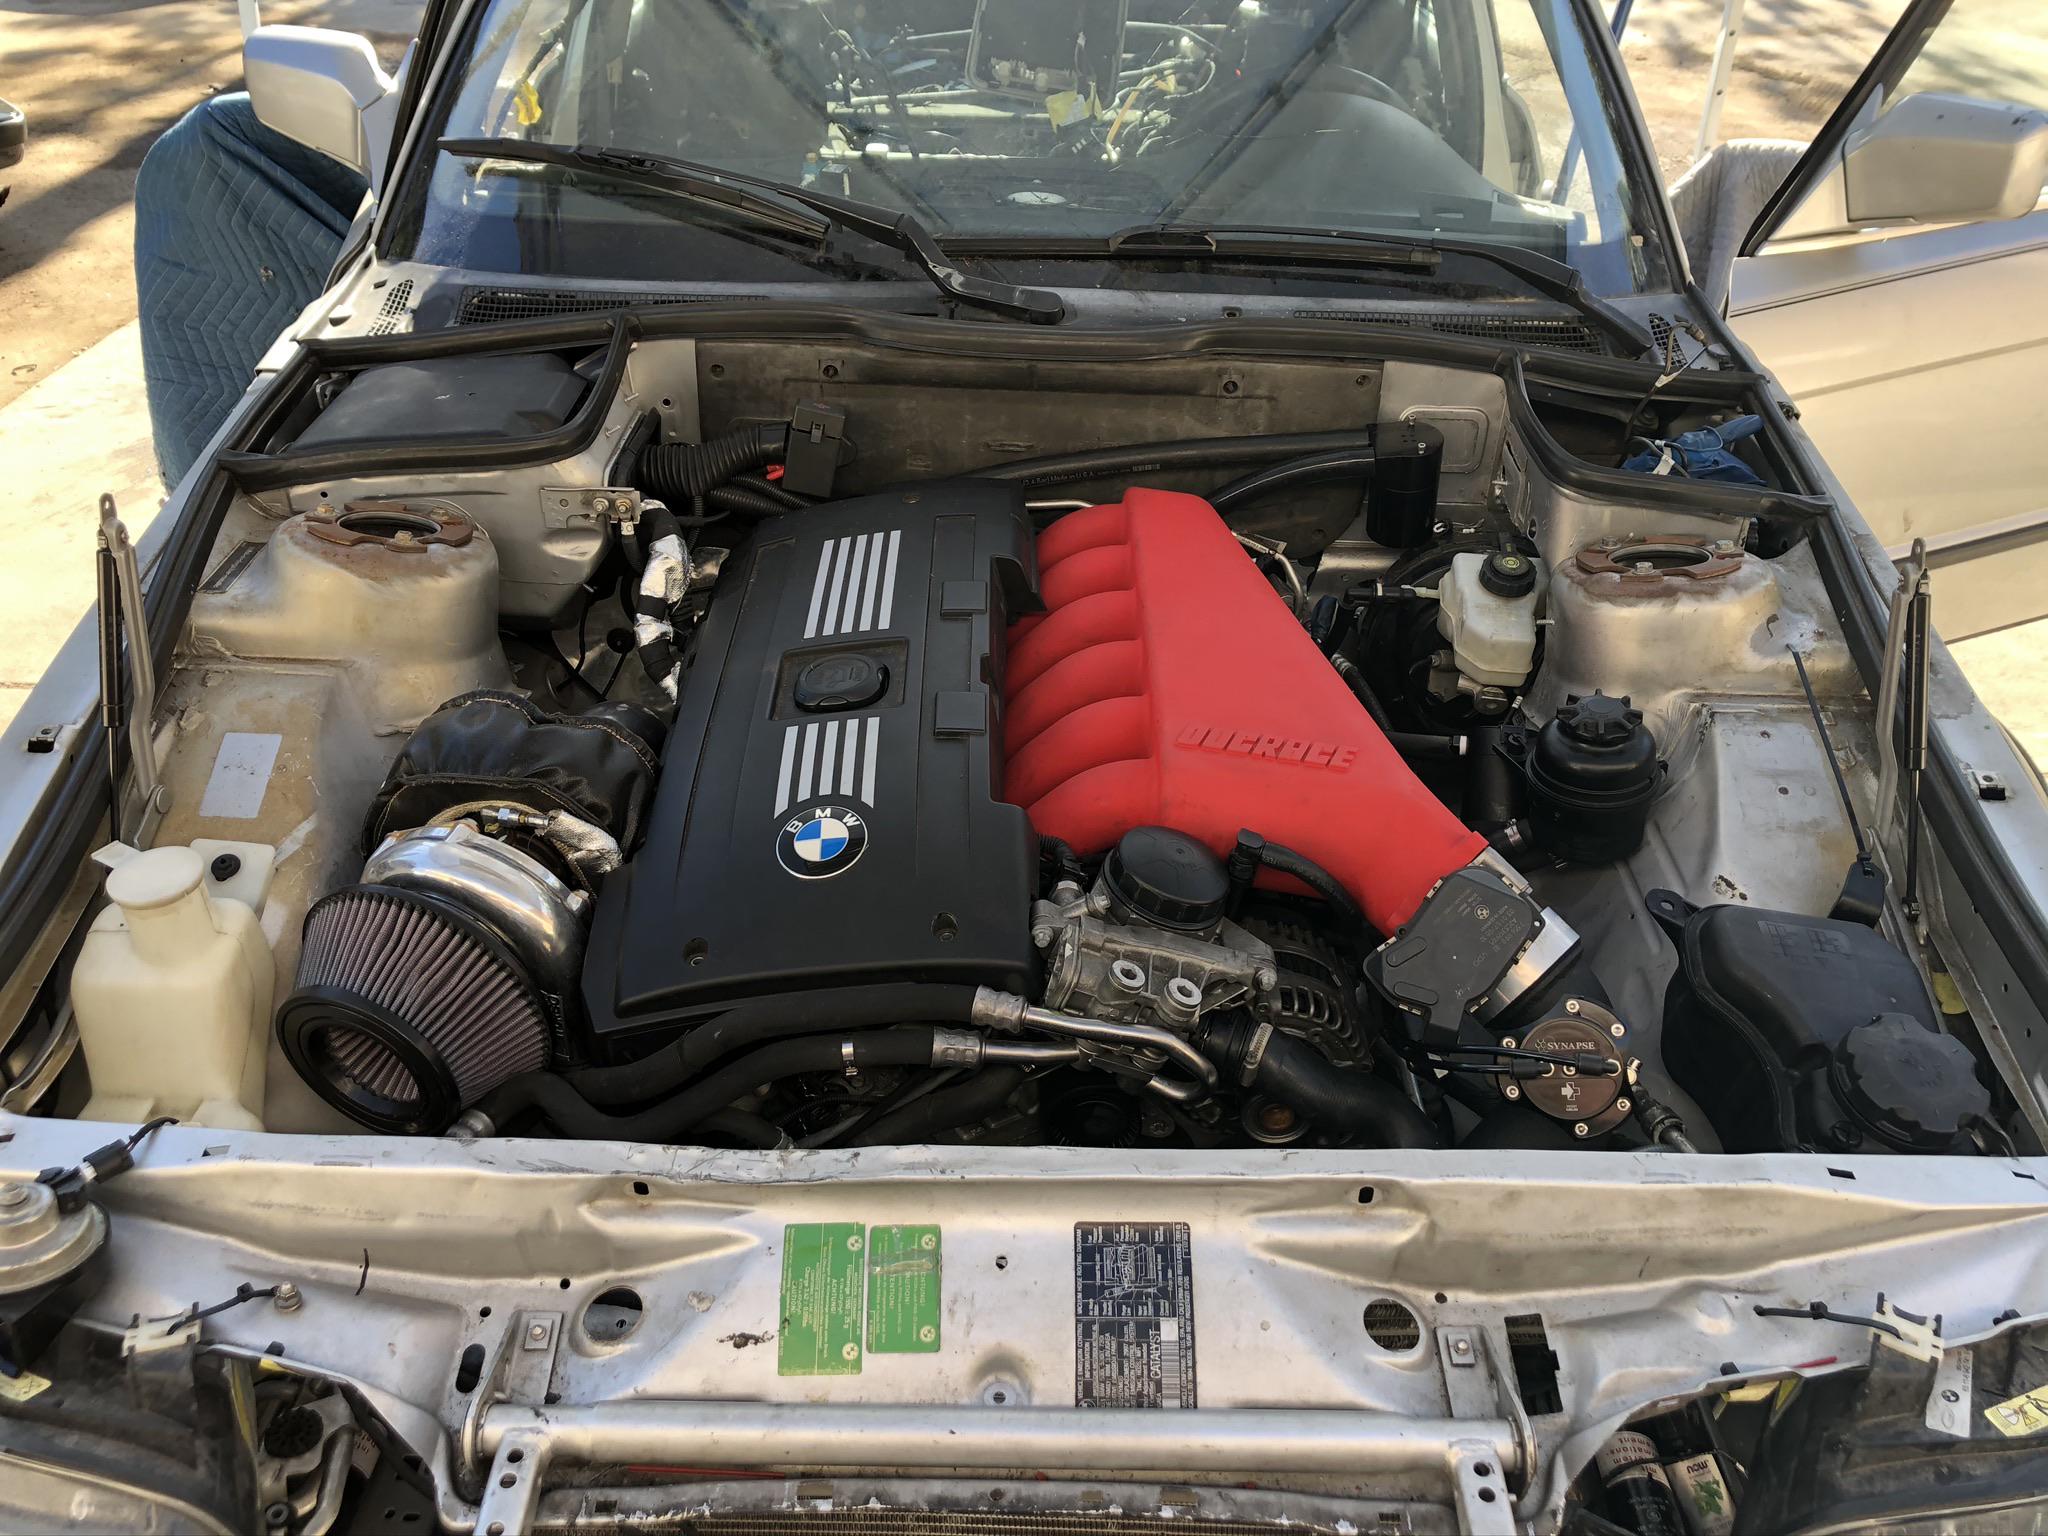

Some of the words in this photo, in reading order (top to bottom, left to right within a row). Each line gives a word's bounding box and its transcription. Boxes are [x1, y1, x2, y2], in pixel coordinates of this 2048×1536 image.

[786, 807, 861, 834] BMW
[1547, 1041, 1596, 1050] SYNAPSE
[1150, 1329, 1161, 1379] CATALYST
